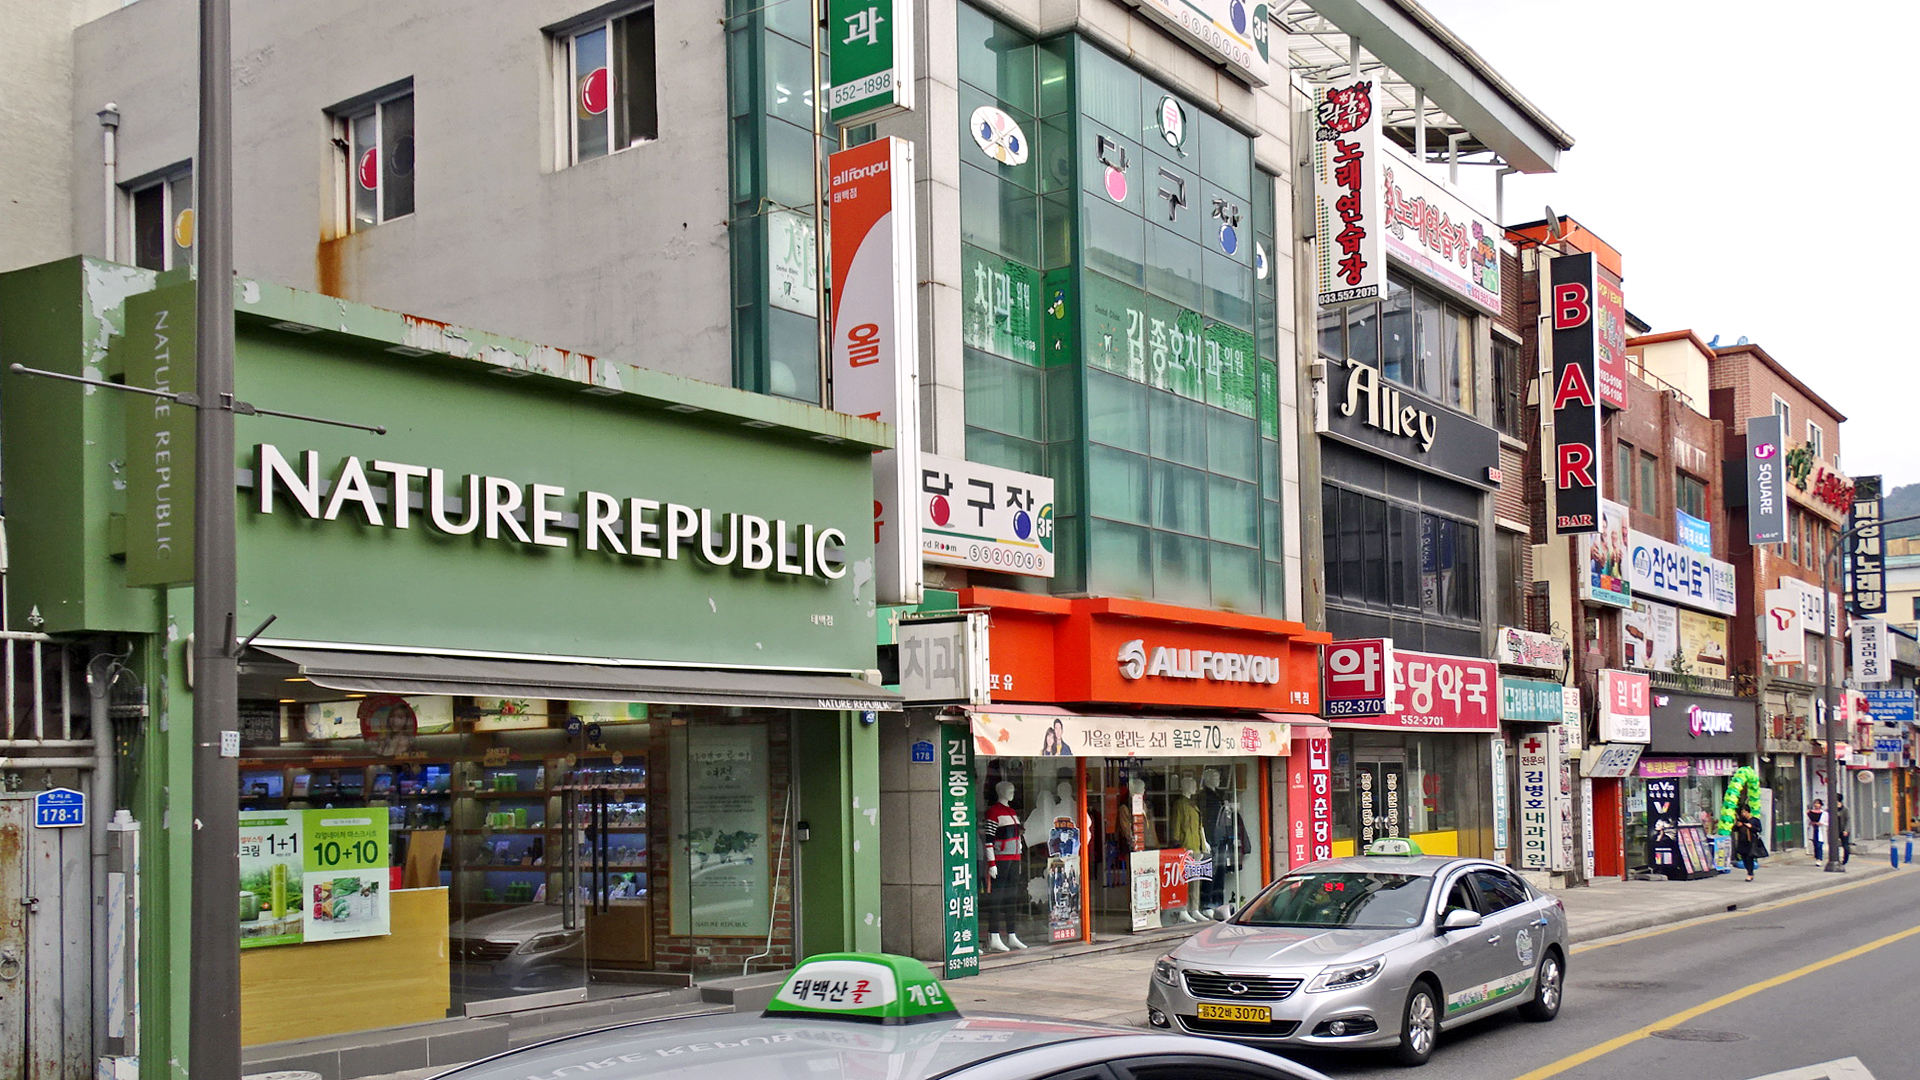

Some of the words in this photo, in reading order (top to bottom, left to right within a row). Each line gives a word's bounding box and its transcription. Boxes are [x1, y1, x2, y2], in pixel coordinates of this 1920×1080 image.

[1253, 16, 1268, 43] 3F
[835, 73, 891, 104] 552-1898
[834, 187, 858, 203] 태백점
[1333, 139, 1367, 286] 노래연습장
[1395, 185, 1470, 269] 노래연습장
[1319, 286, 1378, 305] 033.552.2079
[154, 310, 171, 420] NATURE
[1554, 282, 1596, 490] BAR
[1341, 358, 1436, 452] Alley
[1490, 468, 1501, 481] BAR
[155, 431, 171, 560] REPUBLIC
[1758, 463, 1773, 515] SQUARE
[257, 443, 567, 547] NATURE
[581, 490, 846, 579] REPUBLIC
[1558, 514, 1594, 528] BAR
[1038, 518, 1052, 537] 3F
[1147, 646, 1280, 685] ALLFORYOU
[1329, 648, 1380, 692] 약
[818, 699, 852, 709] NATURE
[853, 701, 892, 710] REPUBLIC
[1617, 680, 1642, 708] 임대
[1331, 699, 1386, 714] 552-3701
[1401, 715, 1444, 726] 552-3701
[1082, 729, 1112, 748] 가을을
[1114, 730, 1146, 749] 알리는
[1148, 731, 1168, 749] 소리
[1172, 728, 1202, 750] 올포유
[916, 752, 930, 761] 178
[1521, 756, 1546, 766] 전문의
[1648, 783, 1659, 791] LG
[42, 808, 80, 822] 178-1
[1524, 771, 1546, 867] 김병호내과의원
[266, 832, 298, 855] 1+1
[314, 839, 379, 866] 10+10
[953, 929, 972, 943] 2층
[949, 957, 977, 970] 552-1898
[906, 981, 944, 1006] 개인
[1235, 1007, 1265, 1020] 3070
